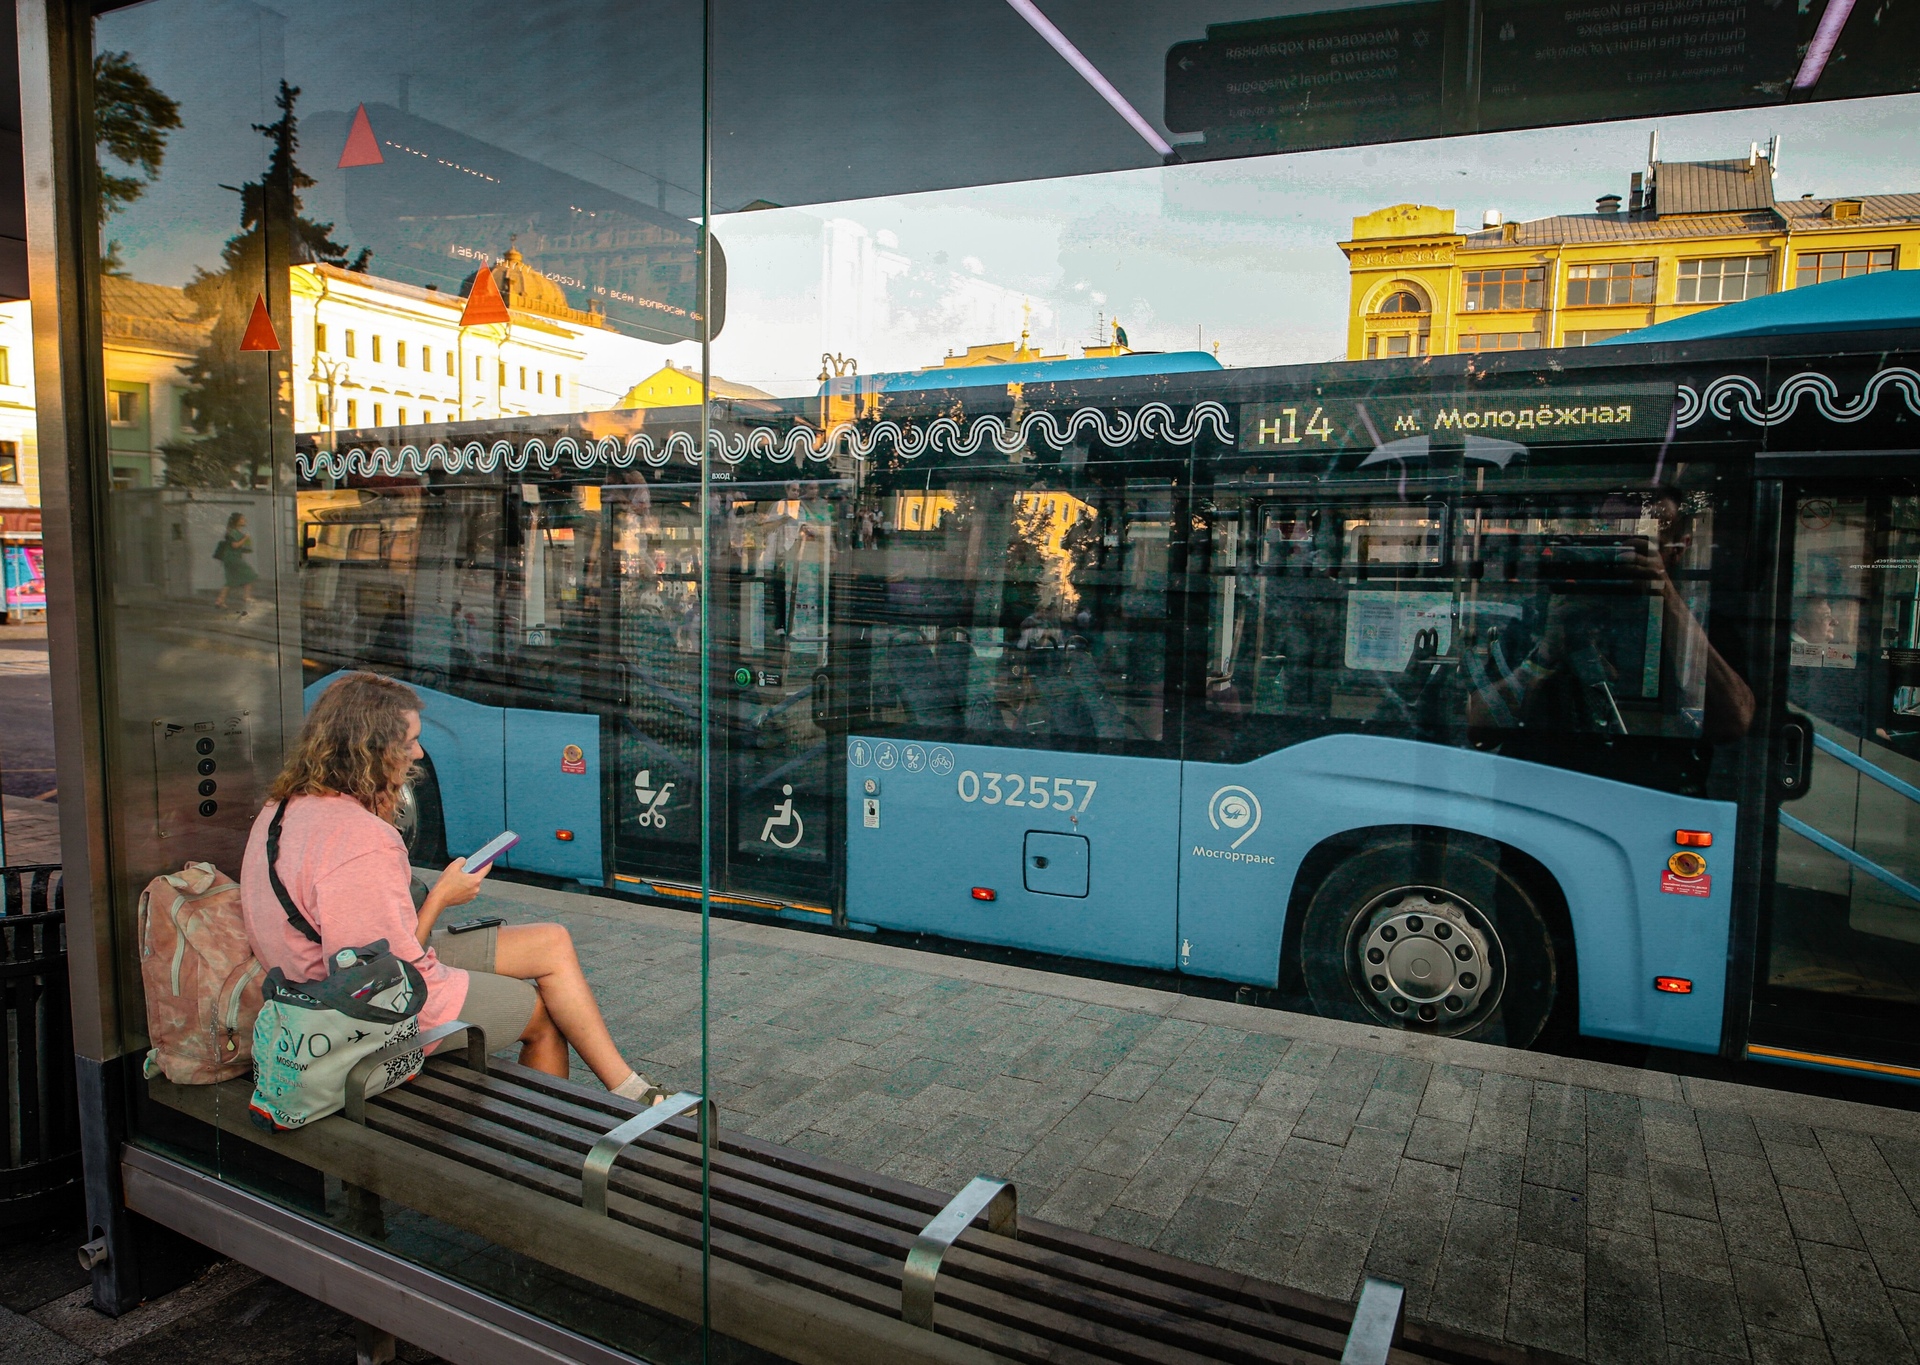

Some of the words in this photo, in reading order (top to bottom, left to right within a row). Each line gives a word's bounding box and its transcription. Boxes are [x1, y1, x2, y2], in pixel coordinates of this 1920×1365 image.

[1433, 404, 1632, 430] Молодёжная
[957, 770, 1098, 813] 032557
[1192, 846, 1275, 864] Мосгортранс
[279, 1026, 331, 1058] SVO
[276, 1055, 308, 1072] MOSCOW
